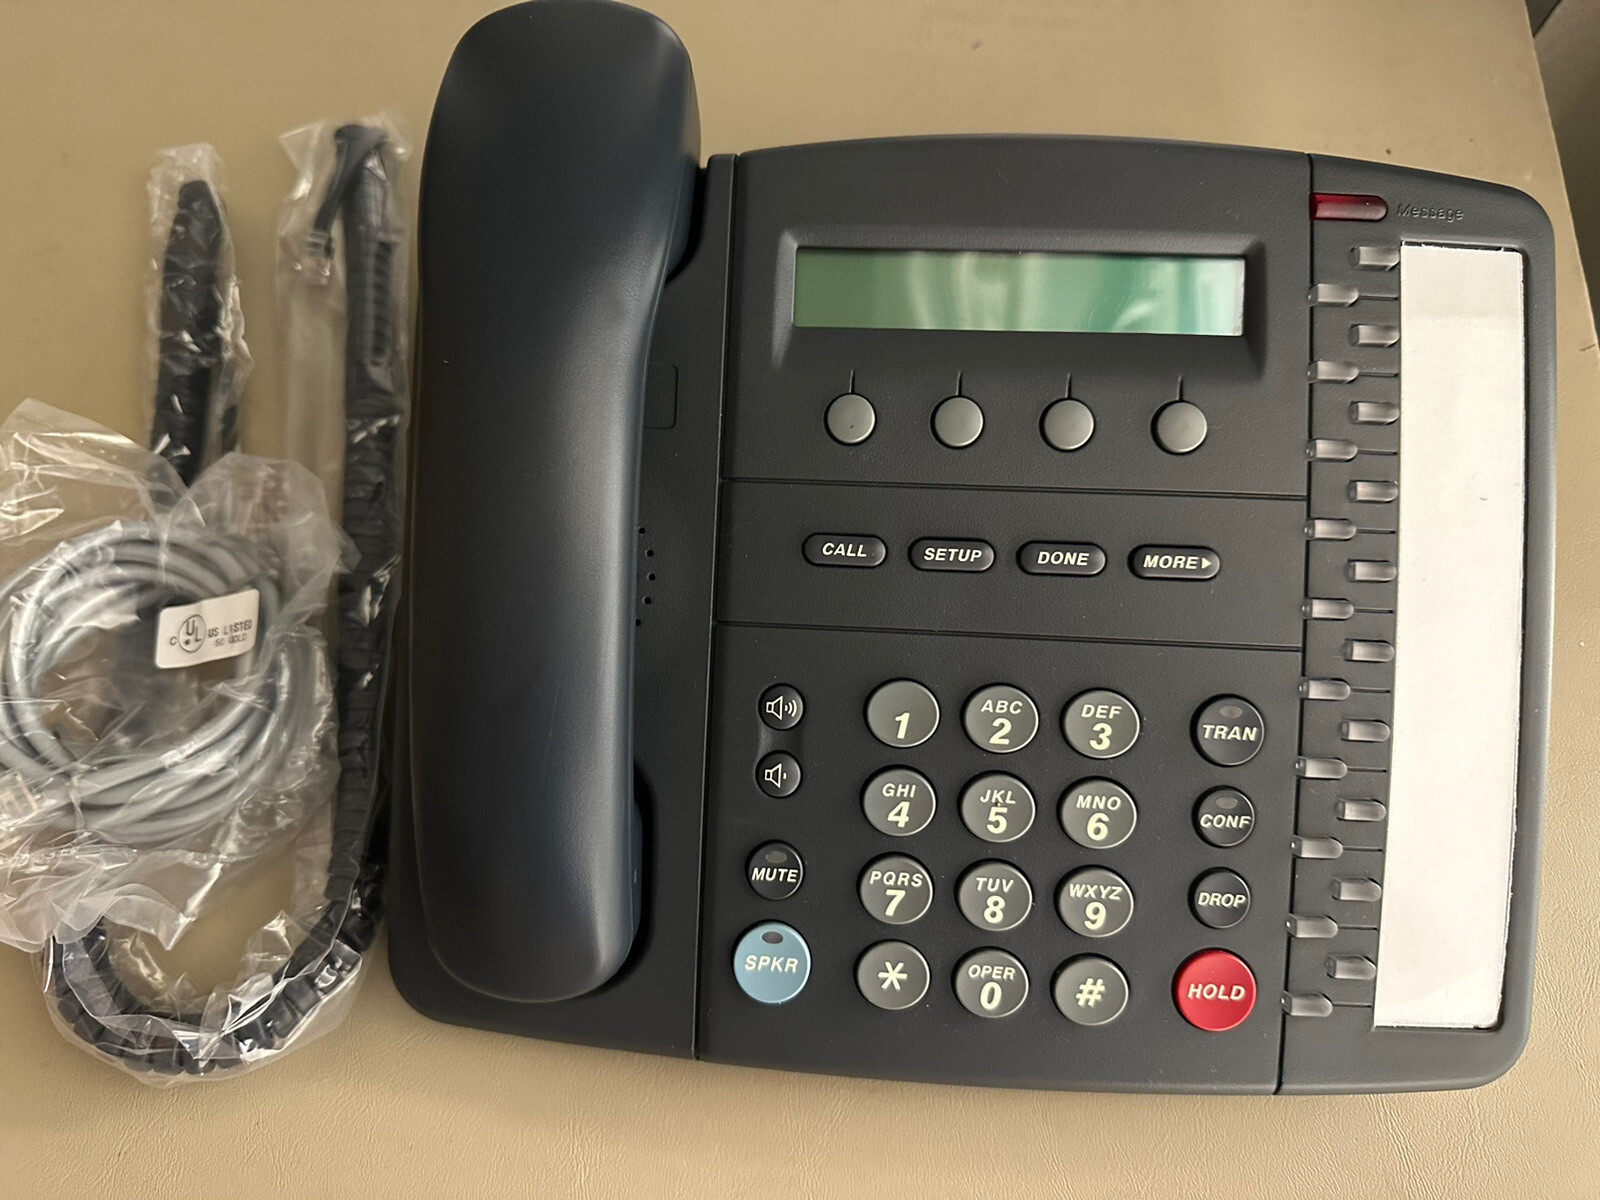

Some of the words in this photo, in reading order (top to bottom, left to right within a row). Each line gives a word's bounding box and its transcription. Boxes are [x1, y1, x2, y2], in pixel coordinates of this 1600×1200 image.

[1397, 203, 1465, 222] Message
[822, 542, 867, 558] CALL
[923, 547, 983, 562] SETUP
[1037, 551, 1090, 566] DONE
[1143, 554, 1197, 570] MORE
[208, 626, 220, 638] US
[223, 619, 253, 635] LISTED
[980, 699, 1023, 715] ABC
[1080, 704, 1122, 719] DEF
[895, 712, 910, 739] 1
[988, 717, 1012, 745] 2
[1202, 724, 1258, 741] TRAN
[1089, 722, 1113, 751] 3
[882, 782, 917, 798] GHI
[979, 789, 1016, 804] JKL
[1076, 794, 1122, 811] MNO
[887, 801, 910, 828] 4
[986, 806, 1008, 834] 5
[1200, 813, 1252, 829] CONF
[1086, 812, 1110, 841] 6
[751, 867, 799, 884] MUTE
[869, 871, 923, 888] PQRS
[975, 877, 1014, 893] TUV
[1069, 883, 1122, 901] WXYZ
[885, 889, 906, 917] 7
[1197, 892, 1247, 908] DROP
[983, 895, 1006, 924] 8
[1084, 901, 1106, 931] 9
[744, 954, 799, 973] SPKR
[968, 963, 1016, 981] OPER
[980, 981, 1002, 1011] 0
[1187, 983, 1246, 1001] HOLD
